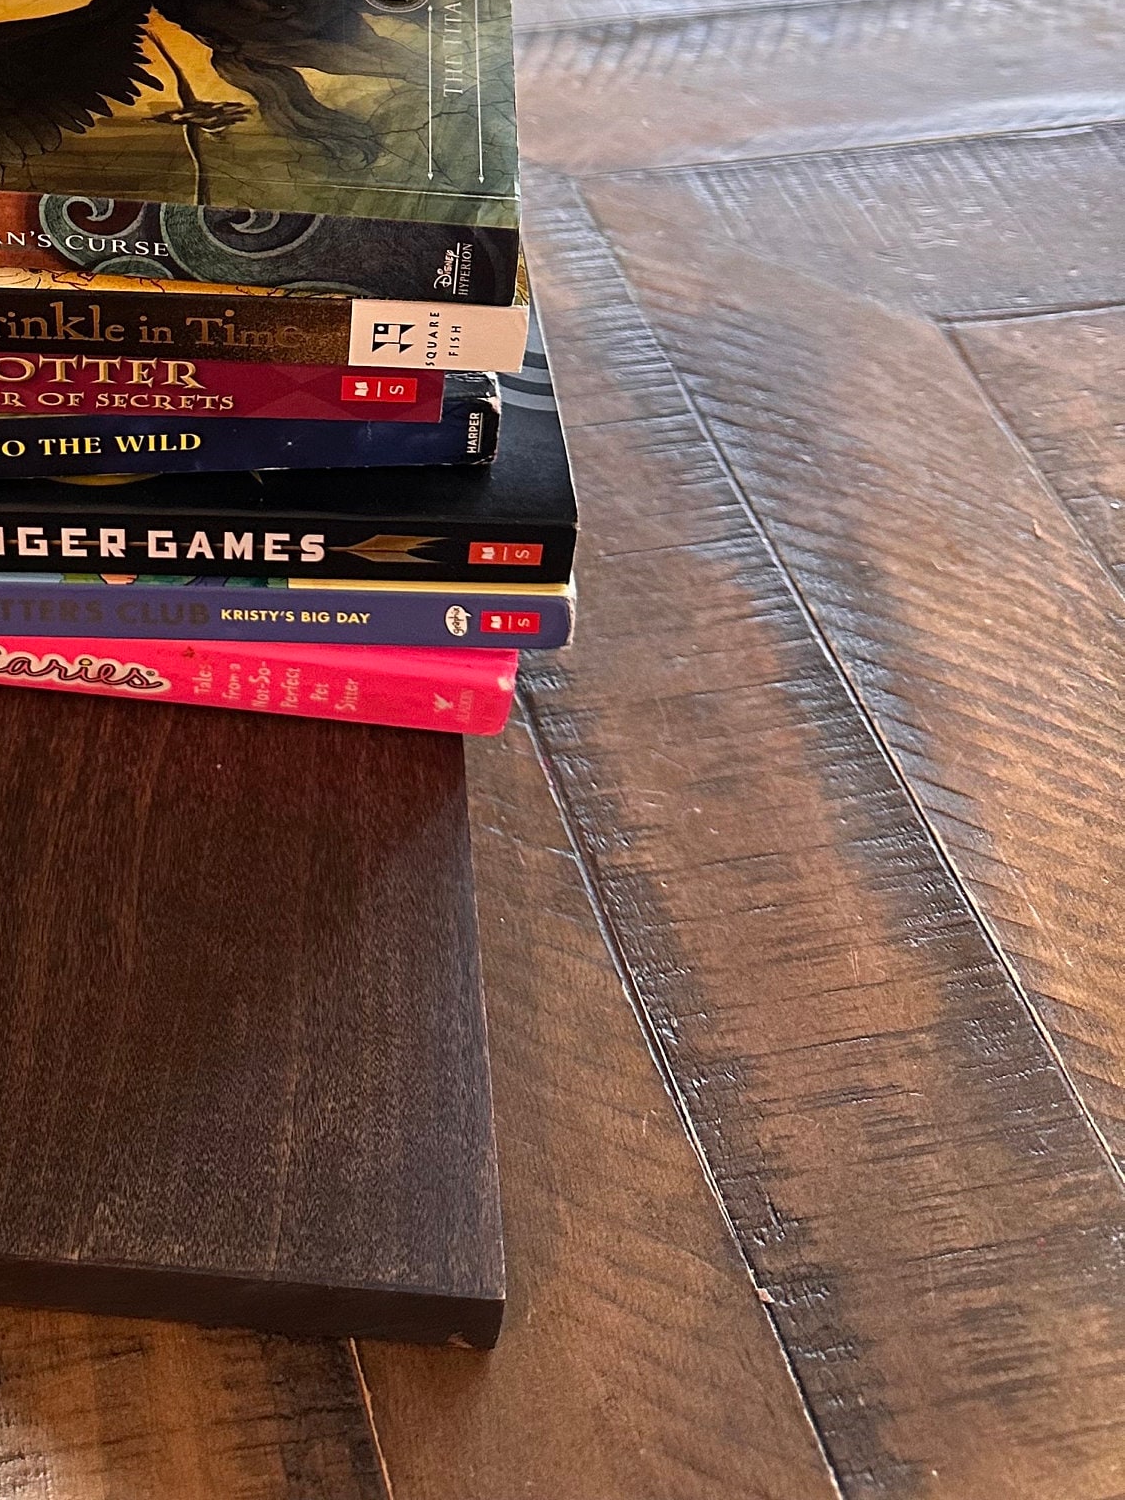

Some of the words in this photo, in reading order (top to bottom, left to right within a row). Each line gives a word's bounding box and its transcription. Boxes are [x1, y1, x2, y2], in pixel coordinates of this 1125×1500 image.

[443, 55, 463, 98] THE
[65, 234, 169, 257] CURSE
[458, 243, 474, 296] HYPERION
[138, 315, 175, 344] in
[186, 309, 307, 348] Time
[425, 311, 441, 367] SQUARE
[448, 325, 462, 357] FISH
[37, 392, 85, 408] OF
[95, 393, 235, 411] SECRETS
[39, 437, 102, 456] THE
[114, 433, 202, 453] WILD
[466, 412, 480, 454] HARPER
[147, 530, 325, 563] GAMES
[113, 602, 211, 626] CLUB
[220, 608, 296, 623] KRISTY'S
[300, 610, 331, 624] BIG
[336, 612, 371, 625] DAY
[449, 606, 465, 635] graphix
[194, 663, 214, 695] Tales
[222, 676, 242, 701] from
[251, 661, 271, 709] Not-So-
[280, 667, 302, 709] Perfect
[309, 683, 330, 702] Pet
[334, 678, 357, 713] Sitter
